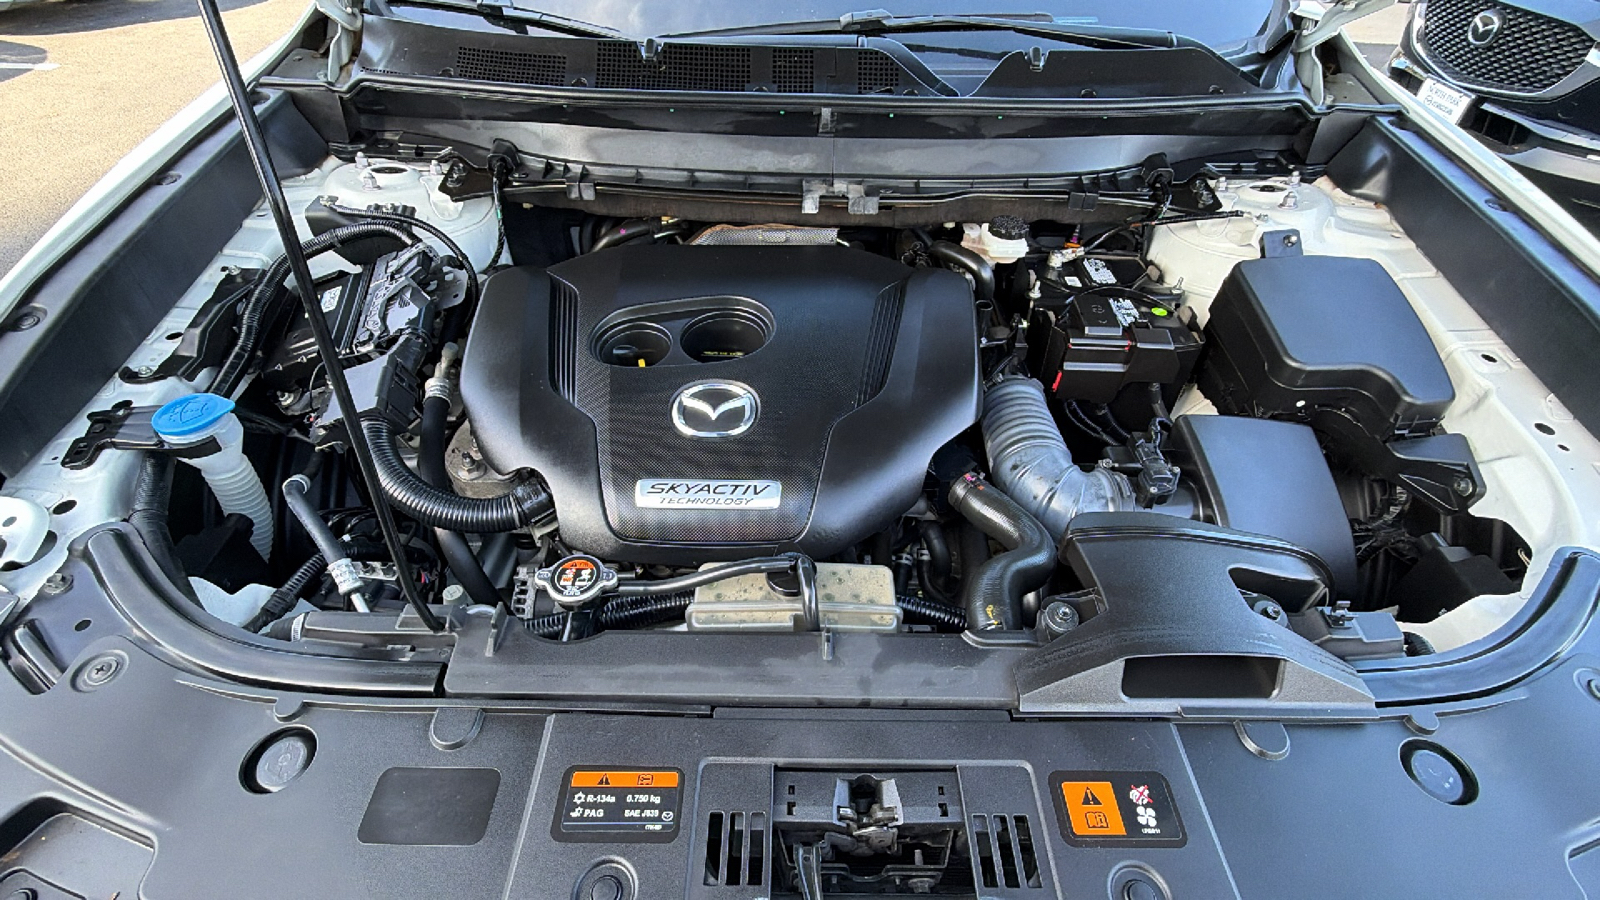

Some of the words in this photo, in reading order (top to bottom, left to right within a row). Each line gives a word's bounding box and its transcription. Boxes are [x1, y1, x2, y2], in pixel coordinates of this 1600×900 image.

[646, 482, 771, 496] SKYACTIV
[659, 497, 754, 506] TECHNOLOGY
[586, 794, 616, 803] R-134a
[626, 794, 649, 803] 0.750
[650, 794, 661, 804] kg
[583, 809, 604, 817] PAG
[624, 809, 640, 817] SAE
